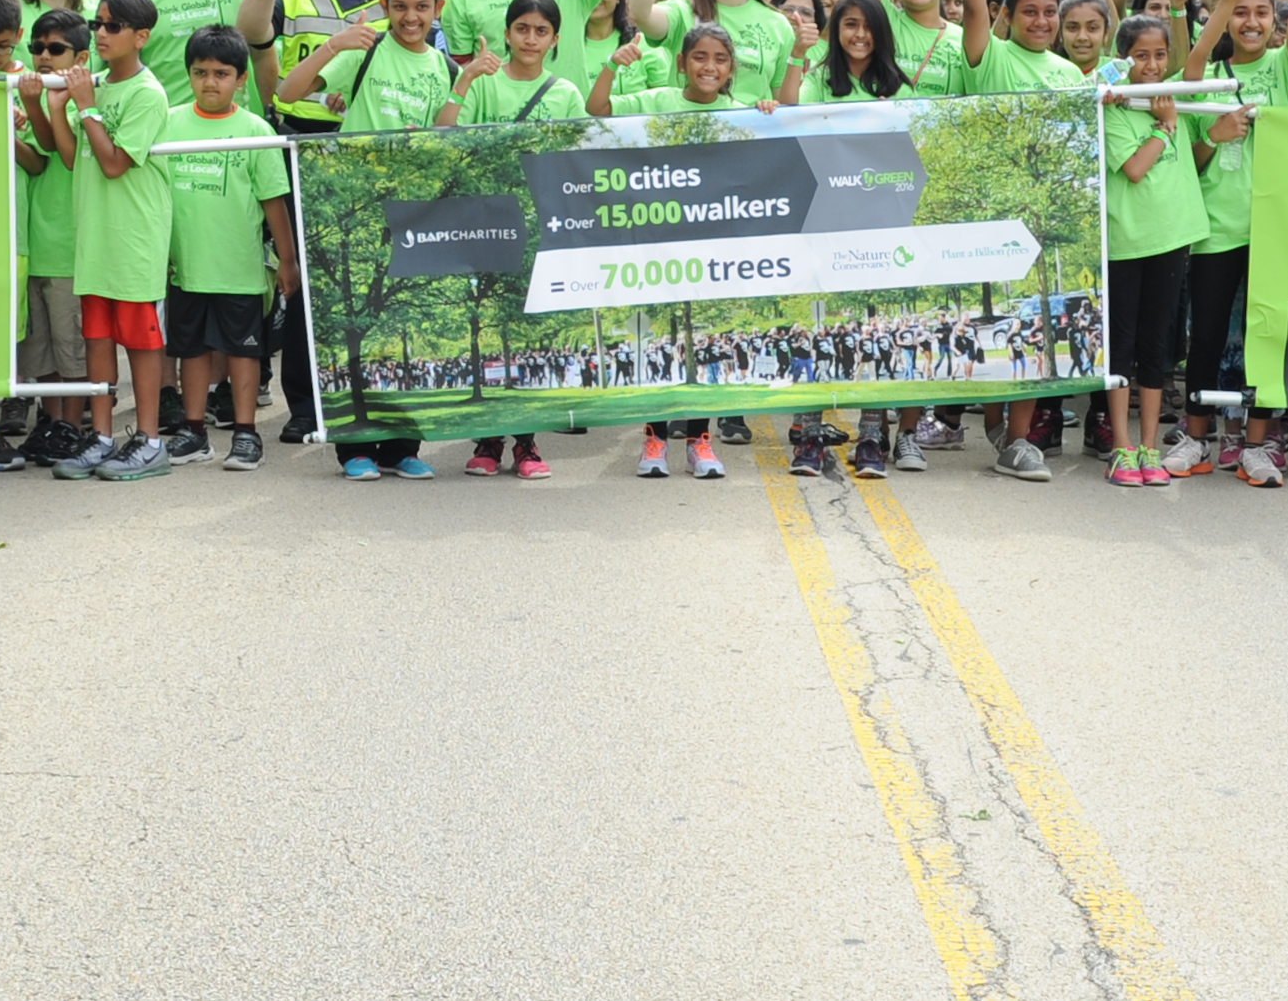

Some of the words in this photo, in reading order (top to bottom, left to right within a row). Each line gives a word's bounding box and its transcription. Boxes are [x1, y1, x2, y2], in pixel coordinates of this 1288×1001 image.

[368, 77, 392, 89] Think
[920, 82, 945, 91] GREEN
[186, 154, 224, 167] Globally
[190, 164, 224, 177] Locally
[562, 181, 593, 194] Over
[593, 168, 627, 193] 50
[629, 165, 701, 191] cities
[828, 173, 863, 188] WALK
[874, 171, 914, 185] GREEN
[197, 183, 222, 192] GREEN
[895, 182, 915, 192] 2016
[564, 216, 595, 231] Over
[595, 200, 682, 230] 15,000
[682, 195, 790, 223] walkers
[833, 251, 848, 261] The
[848, 249, 891, 261] Nature
[941, 249, 964, 260] Plant
[975, 247, 1005, 257] Billion
[832, 260, 891, 272] Conservancy
[570, 279, 599, 293] Over
[599, 258, 703, 291] 70,000
[708, 256, 791, 282] trees
